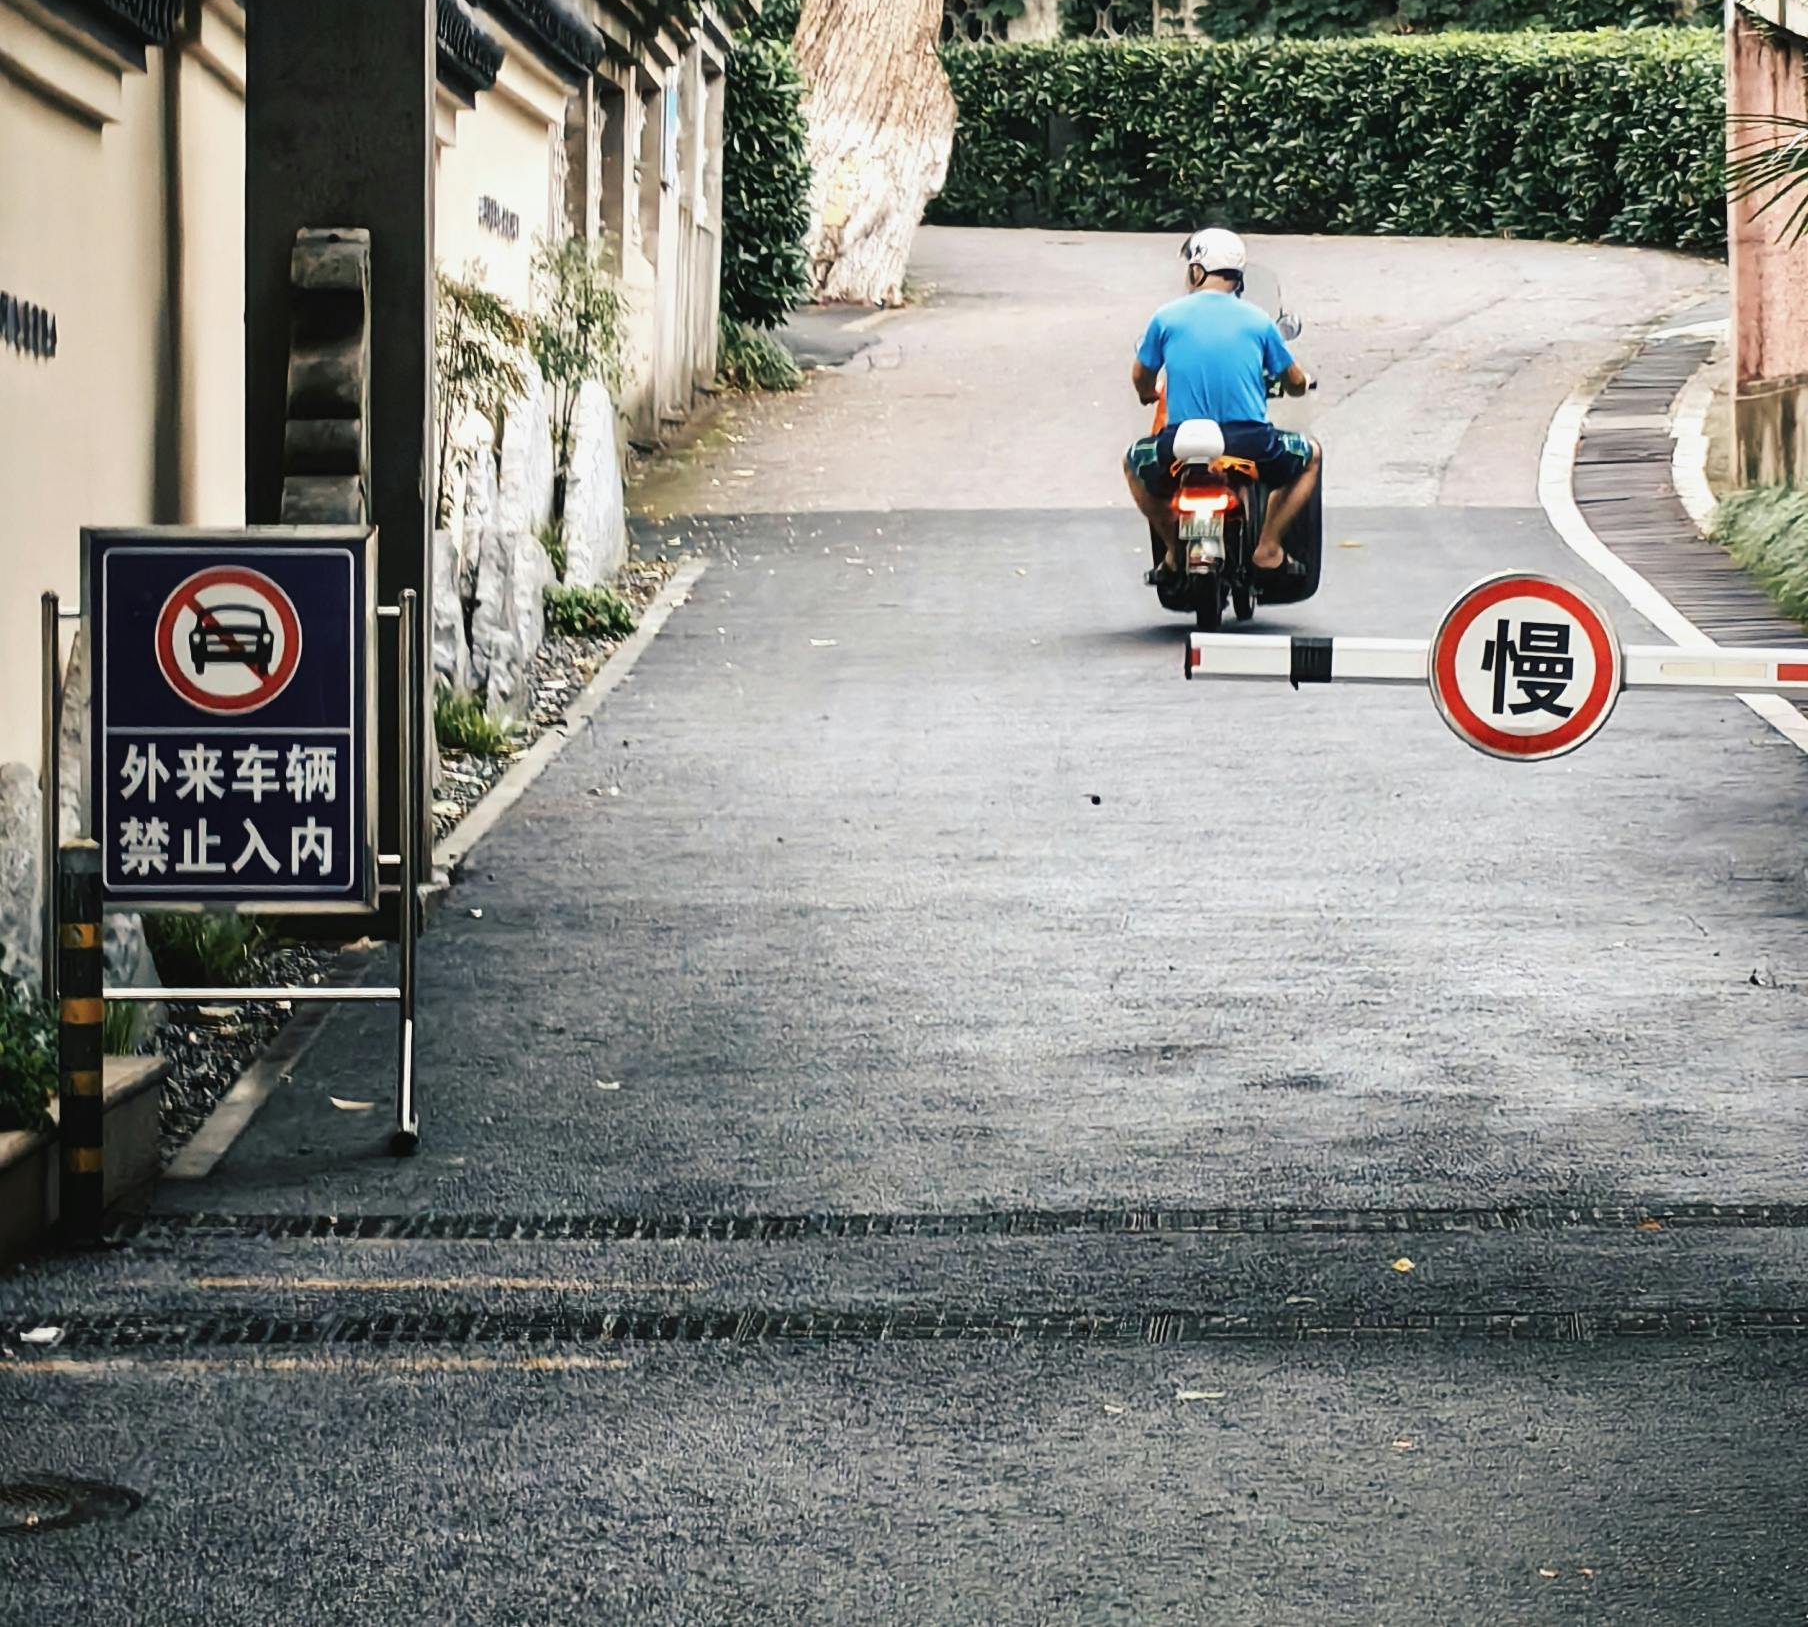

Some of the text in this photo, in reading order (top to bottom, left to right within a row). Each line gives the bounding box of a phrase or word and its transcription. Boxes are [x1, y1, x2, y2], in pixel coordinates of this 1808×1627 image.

[1481, 619, 1574, 718] 慢
[120, 743, 337, 803] 外来车辆
[119, 816, 334, 876] 禁止入内
